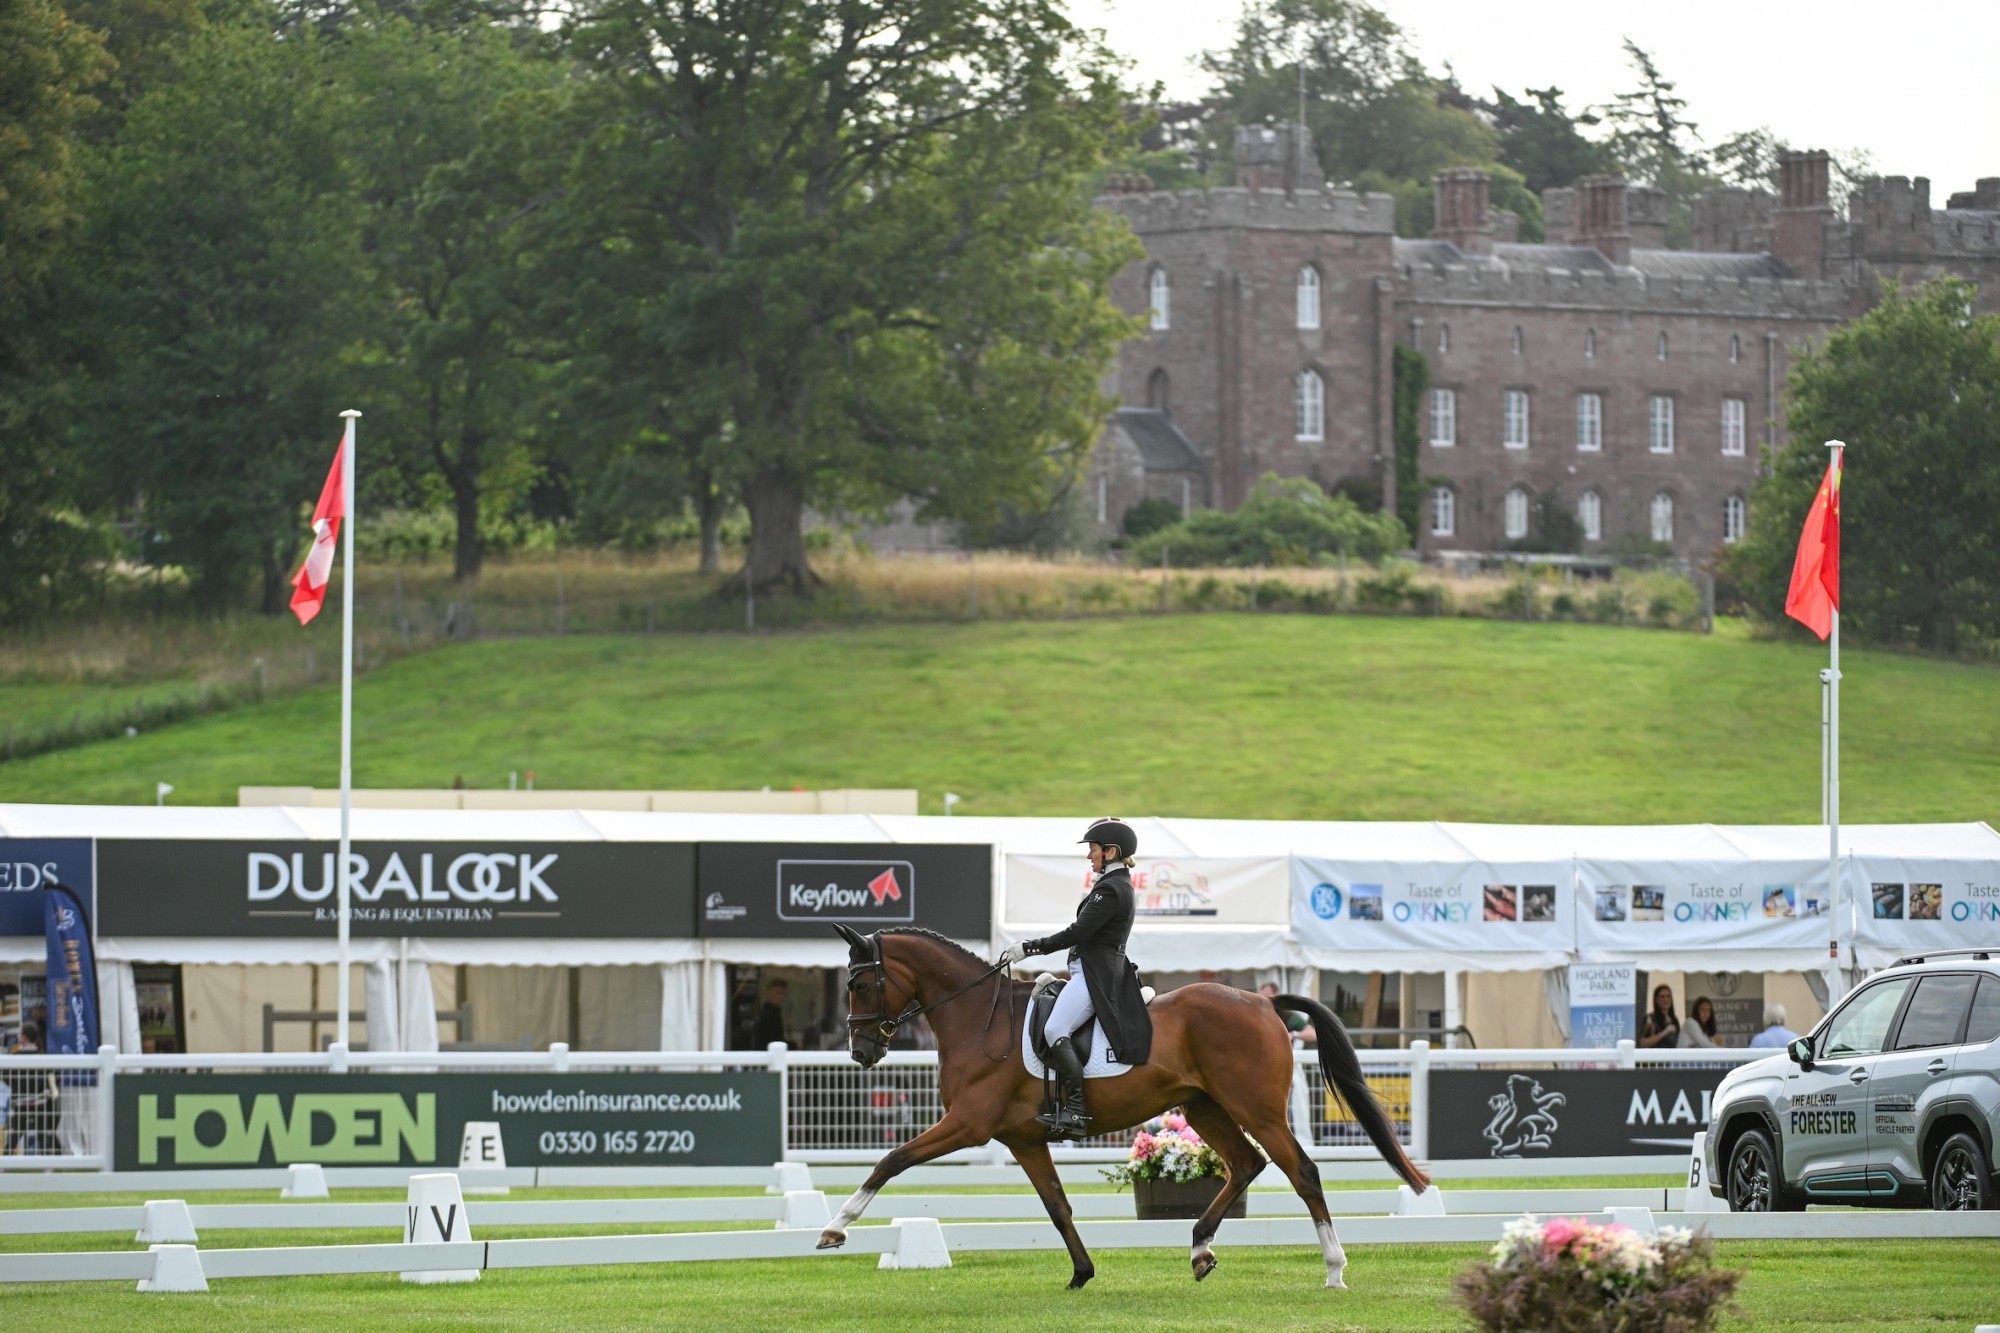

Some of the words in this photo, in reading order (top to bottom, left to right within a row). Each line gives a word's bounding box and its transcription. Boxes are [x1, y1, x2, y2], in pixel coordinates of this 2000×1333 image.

[247, 851, 559, 902] DURALOCK
[789, 883, 868, 912] Keyflow
[1407, 882, 1443, 898] Taste
[1447, 882, 1463, 898] of
[1688, 882, 1724, 898] Taste
[1729, 882, 1744, 897] of
[1964, 882, 2000, 897] Taste
[1168, 893, 1191, 908] LTD
[315, 907, 377, 922] RAING
[393, 907, 493, 923] EQUESTRIAN
[1393, 901, 1473, 923] ORKNEY
[1674, 901, 1752, 923] ORKNEY
[1575, 969, 1630, 980] HIGHLAND
[1590, 981, 1616, 991] PARK
[1585, 1025, 1625, 1039] ABOUT
[492, 1087, 742, 1113] howdeninsurance.co.uk
[1792, 1095, 1805, 1107] THE
[1806, 1094, 1837, 1106] ALL-NEW
[1791, 1110, 1857, 1135] FORESTER
[1875, 1115, 1896, 1123] OFFICIAL
[138, 1093, 437, 1165] HOWDEN
[1875, 1126, 1895, 1134] VEHICLE
[1896, 1126, 1915, 1134] PARTNER
[482, 1135, 495, 1161] E
[539, 1130, 597, 1155] 0330
[603, 1130, 638, 1154] 165
[643, 1129, 695, 1154] 2720
[1691, 1157, 1701, 1188] B
[430, 1204, 457, 1242] V
